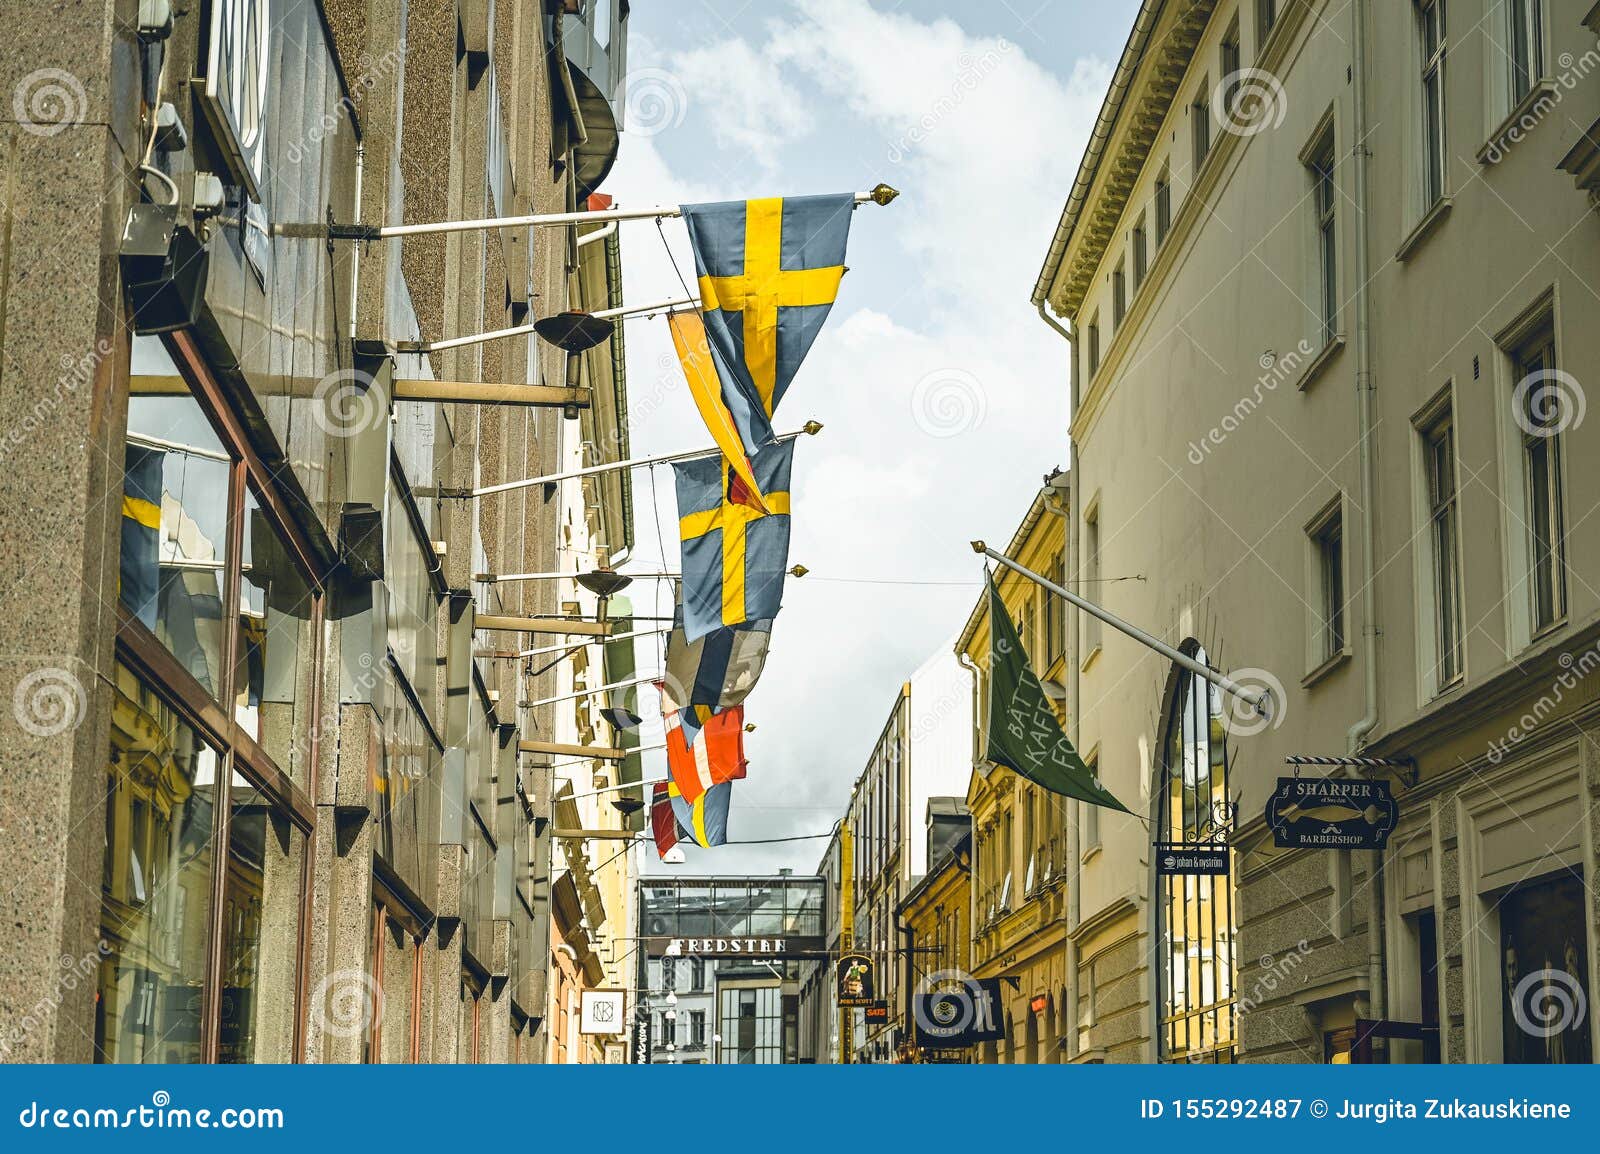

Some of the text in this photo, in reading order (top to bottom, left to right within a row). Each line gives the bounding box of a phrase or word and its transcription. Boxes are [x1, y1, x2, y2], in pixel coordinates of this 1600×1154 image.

[1296, 782, 1371, 797] SHARPER
[1300, 834, 1363, 844] BARBERSHOP
[1177, 856, 1223, 869] johan & nyström
[866, 1008, 886, 1016] SATS
